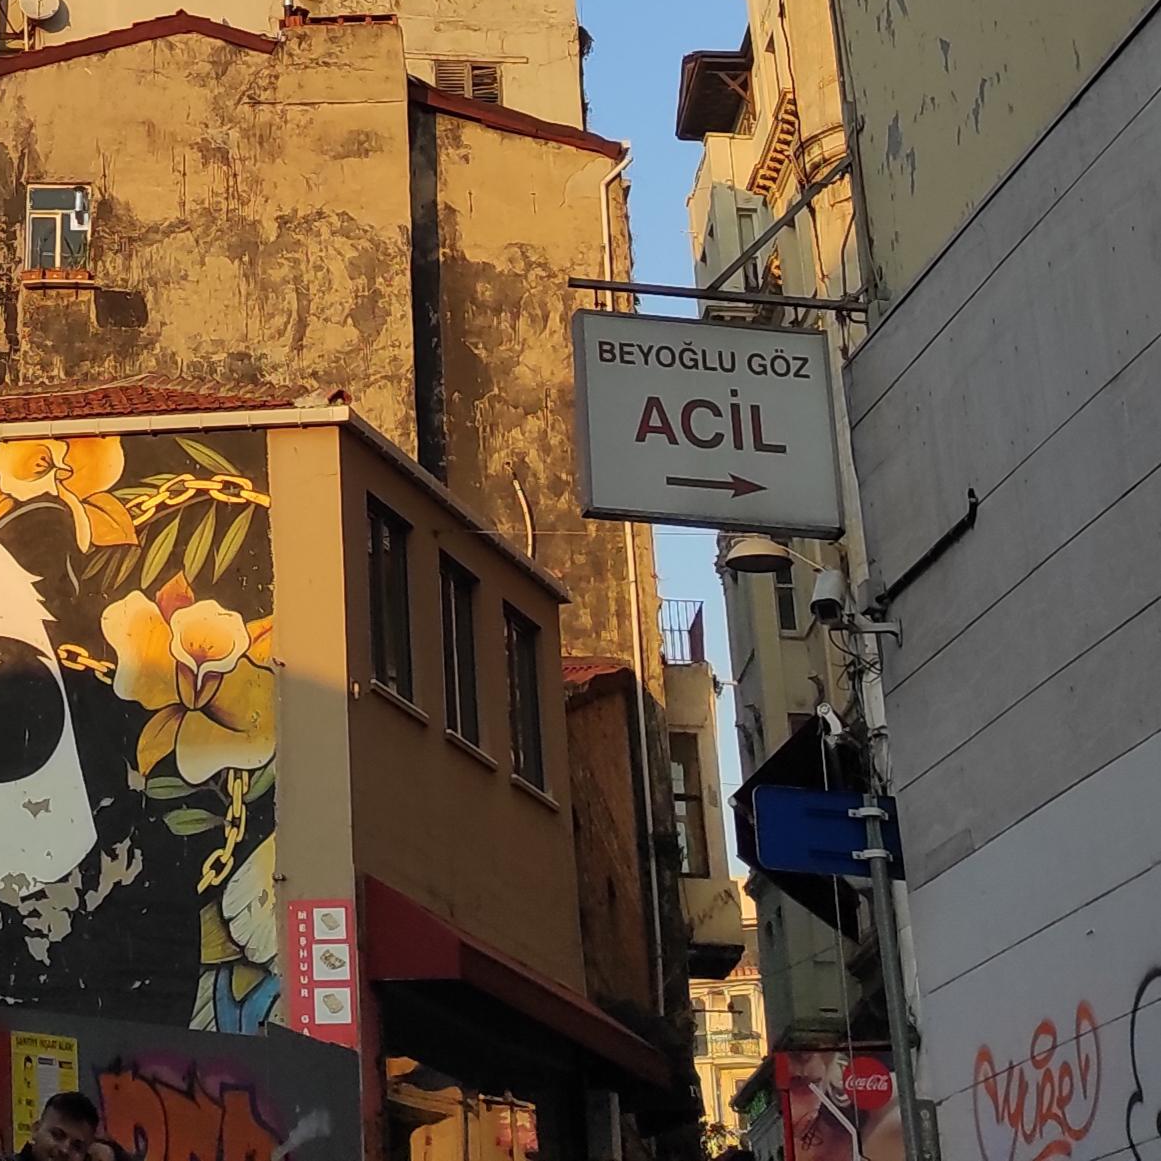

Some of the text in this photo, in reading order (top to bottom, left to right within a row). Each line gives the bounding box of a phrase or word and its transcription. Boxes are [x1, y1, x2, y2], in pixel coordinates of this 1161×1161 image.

[598, 340, 811, 379] BEYOĞLU GÖZ
[634, 388, 787, 454] ACİL
